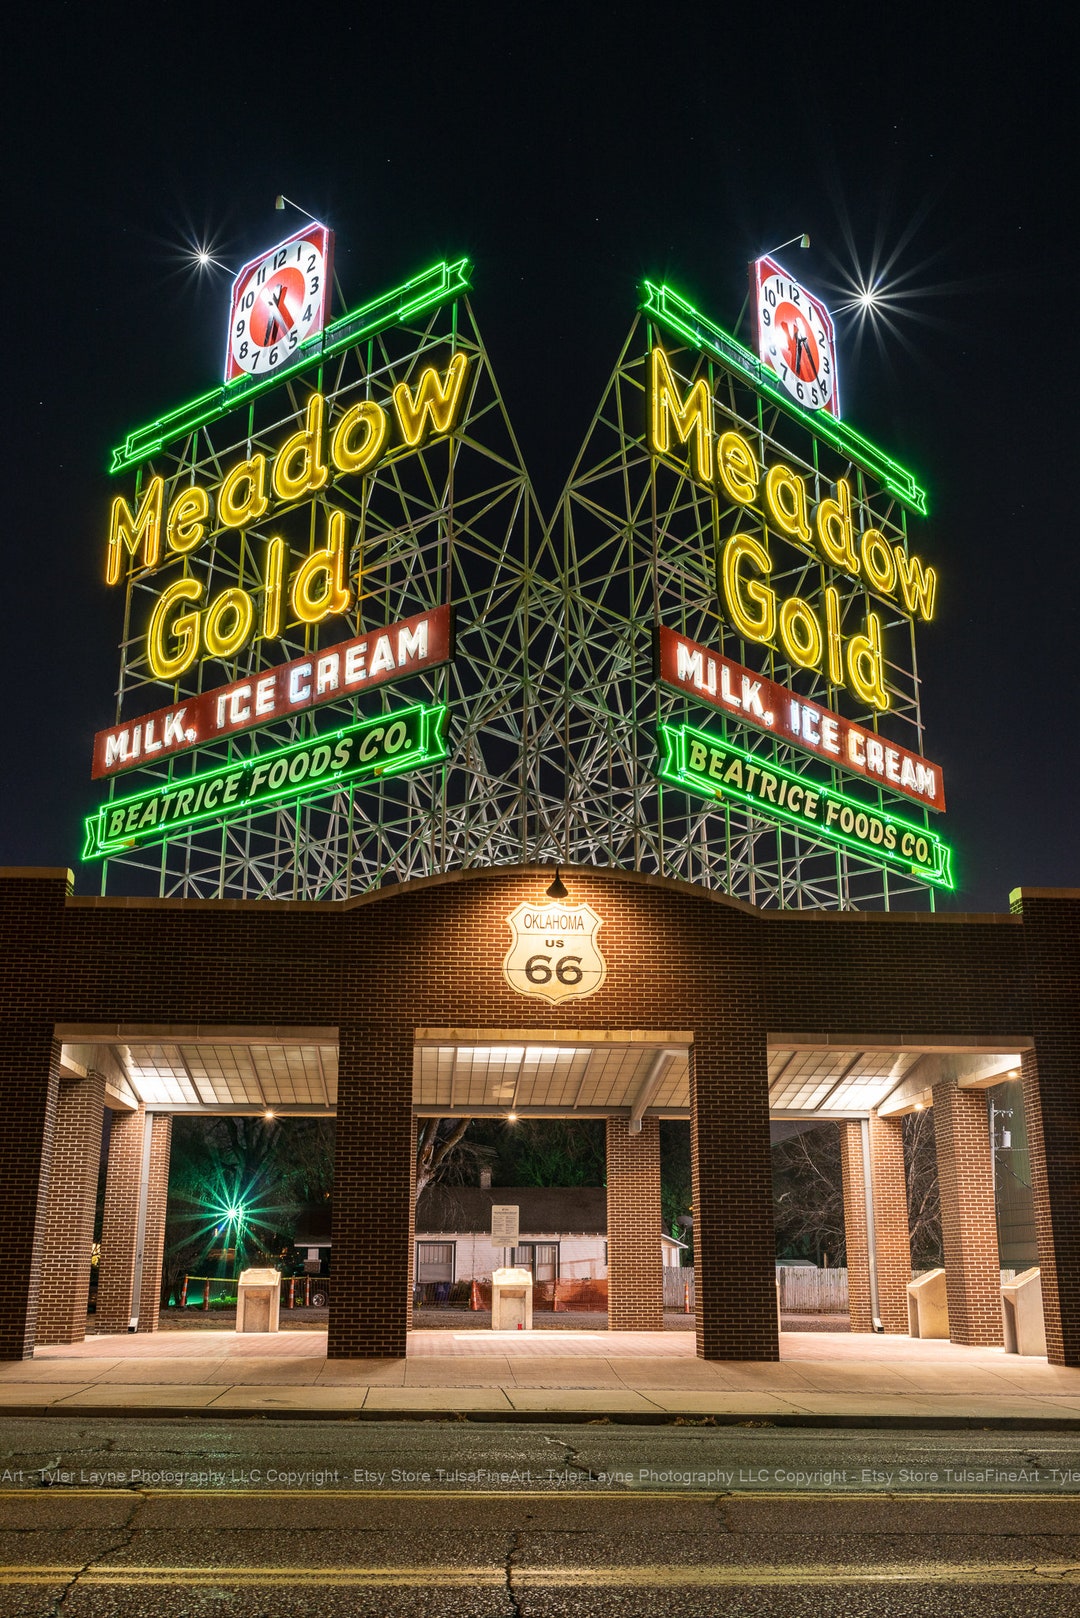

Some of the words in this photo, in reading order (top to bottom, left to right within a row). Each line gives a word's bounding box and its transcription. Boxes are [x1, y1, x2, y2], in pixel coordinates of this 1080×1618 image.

[273, 249, 287, 270] 12
[307, 254, 316, 273] 2
[257, 266, 266, 286] 11
[310, 276, 319, 295] 3
[764, 286, 776, 307] 10
[776, 279, 783, 297] 11
[789, 284, 800, 306] 12
[241, 291, 254, 312] 10
[302, 304, 312, 322] 4
[763, 308, 771, 327] 9
[236, 320, 245, 338] 9
[289, 330, 298, 350] 5
[818, 330, 825, 349] 2
[239, 341, 248, 359] 8
[269, 347, 278, 365] 6
[251, 351, 260, 370] 7
[823, 357, 830, 374] 3
[780, 362, 788, 381] 7
[796, 382, 804, 400] 6
[812, 387, 818, 405] 5
[107, 353, 468, 585] Meadow
[652, 348, 936, 621] Meadow
[148, 511, 350, 679] Gold
[722, 534, 889, 710] Gold
[105, 708, 197, 768] MILK,
[216, 675, 276, 729] ICE
[289, 620, 429, 703] CREAM
[677, 642, 774, 727] MILK,
[790, 698, 840, 754] ICE
[848, 729, 936, 800] CREAM
[108, 772, 242, 837] BEATRICE
[249, 739, 352, 795] FOODS
[358, 721, 412, 762] CO.
[689, 740, 820, 820] BEATRICE
[825, 800, 898, 850] FOODS
[901, 833, 932, 865] CO.
[523, 913, 584, 930] OKLAHOMA
[545, 939, 564, 948] US
[525, 954, 583, 985] 66
